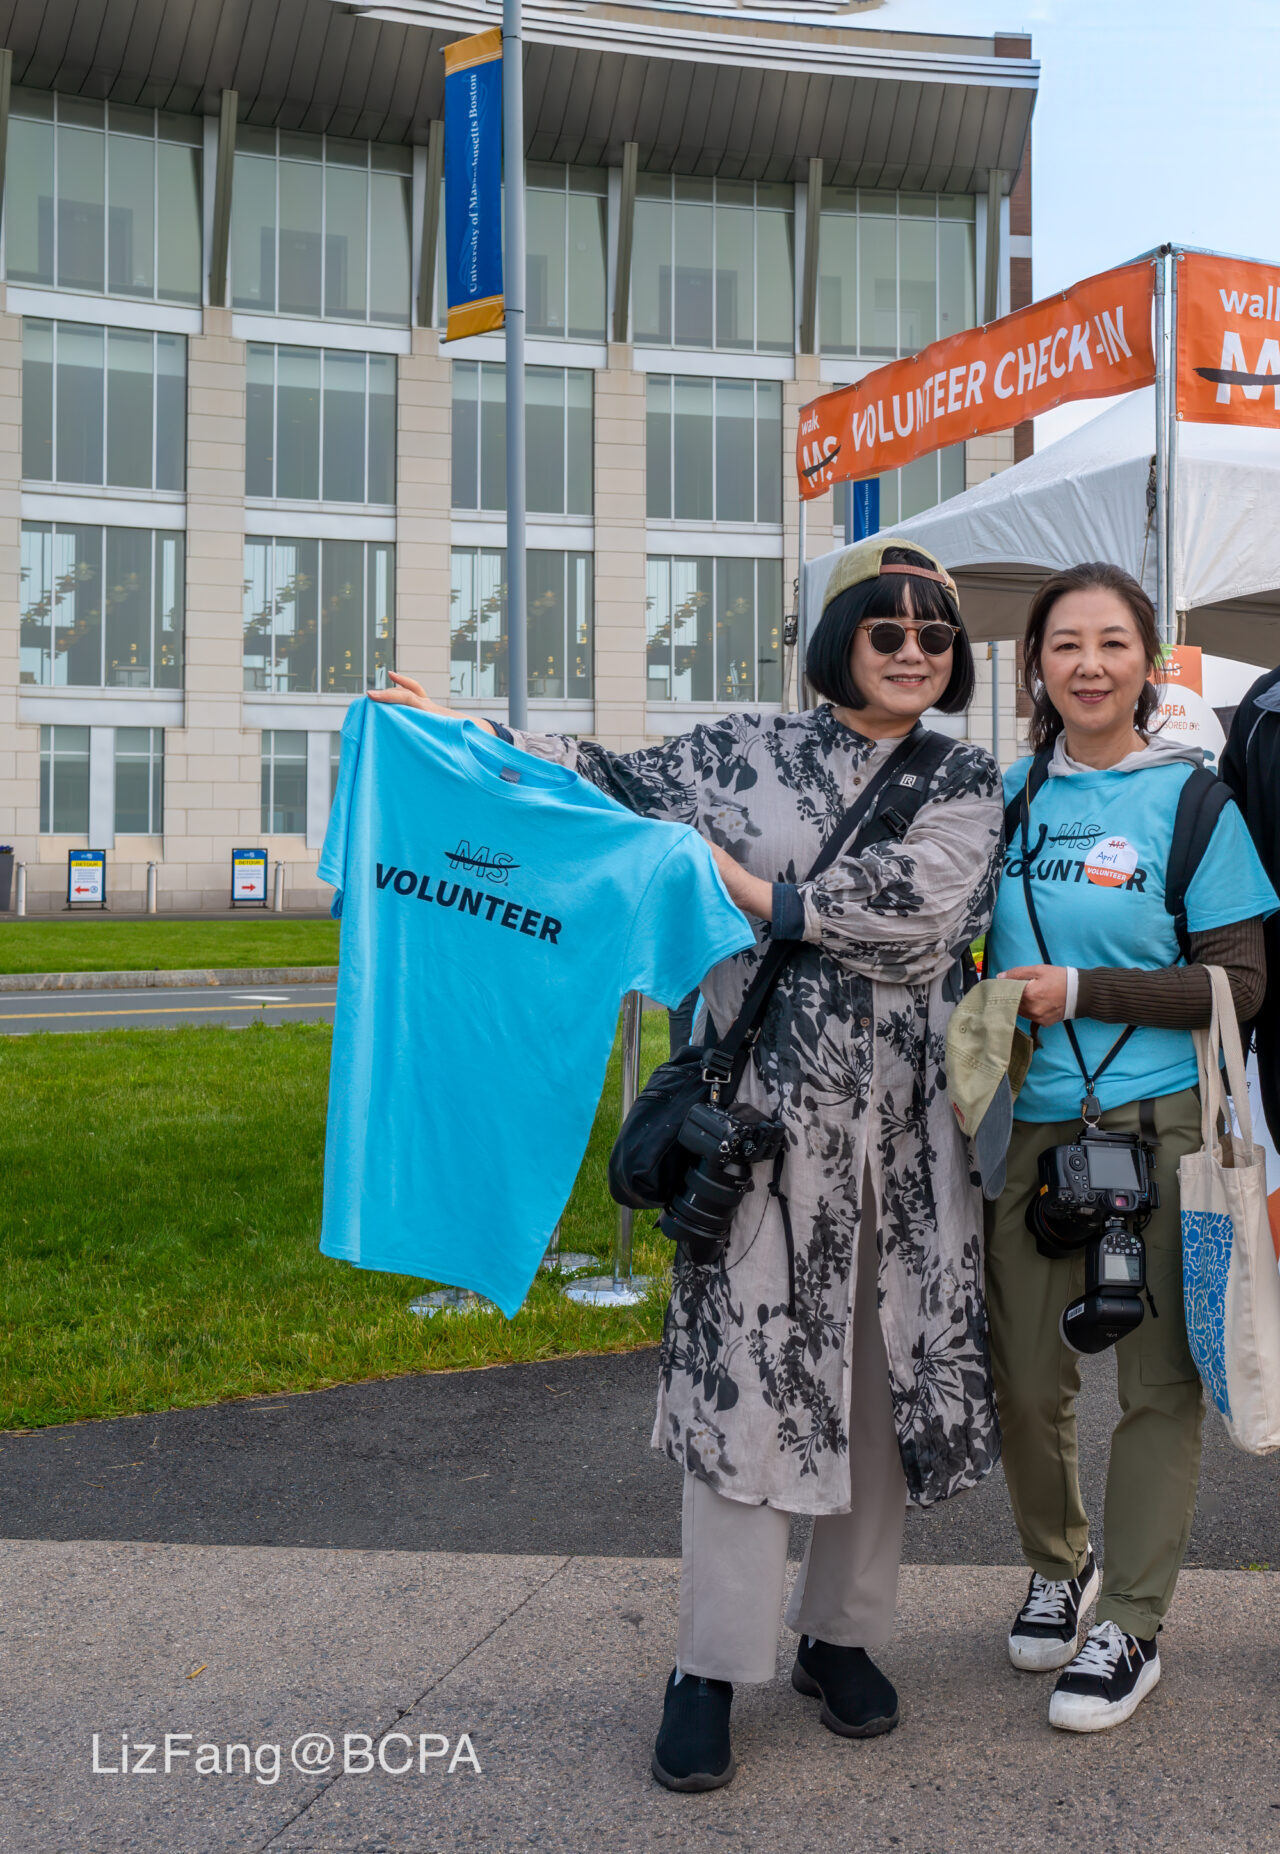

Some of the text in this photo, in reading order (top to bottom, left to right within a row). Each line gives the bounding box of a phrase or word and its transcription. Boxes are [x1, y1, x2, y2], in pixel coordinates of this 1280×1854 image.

[468, 74, 478, 118] Boston
[468, 211, 479, 225] of
[469, 227, 479, 294] University
[852, 305, 1133, 453] VOLUNTEER CHECK-IN
[801, 408, 820, 437] walk
[1158, 703, 1187, 717] AREA
[1149, 719, 1188, 731] PONSORED
[1095, 851, 1118, 865] April
[1087, 867, 1127, 882] VOLUNTEER
[376, 863, 563, 946] VOLUNTEER
